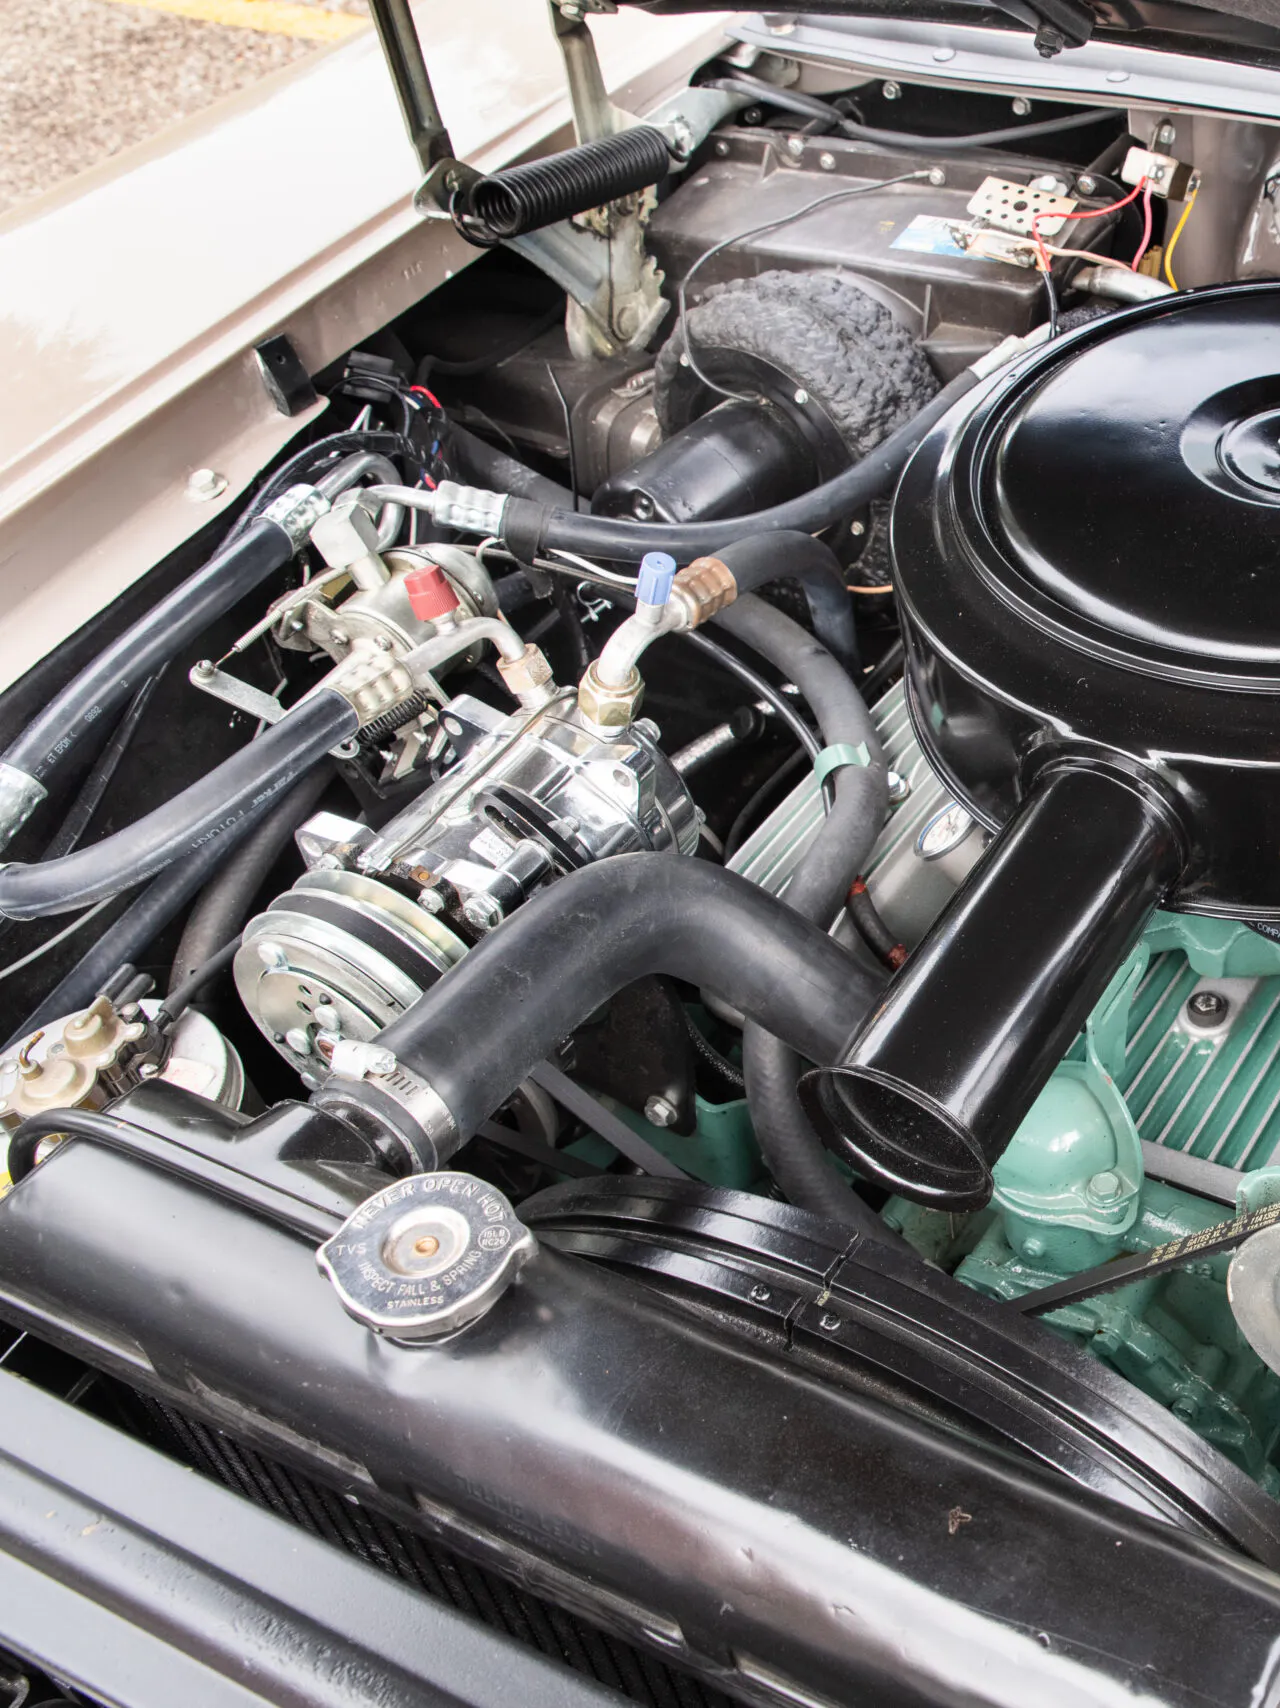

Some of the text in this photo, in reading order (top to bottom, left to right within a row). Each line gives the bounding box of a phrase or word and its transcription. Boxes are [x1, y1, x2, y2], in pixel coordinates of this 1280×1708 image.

[352, 1177, 507, 1229] NEVER OPEN HOT
[336, 1244, 367, 1256] TVS
[358, 1249, 483, 1297] INSPECT FALL & SPRING
[387, 1295, 444, 1310] STAINLESS
